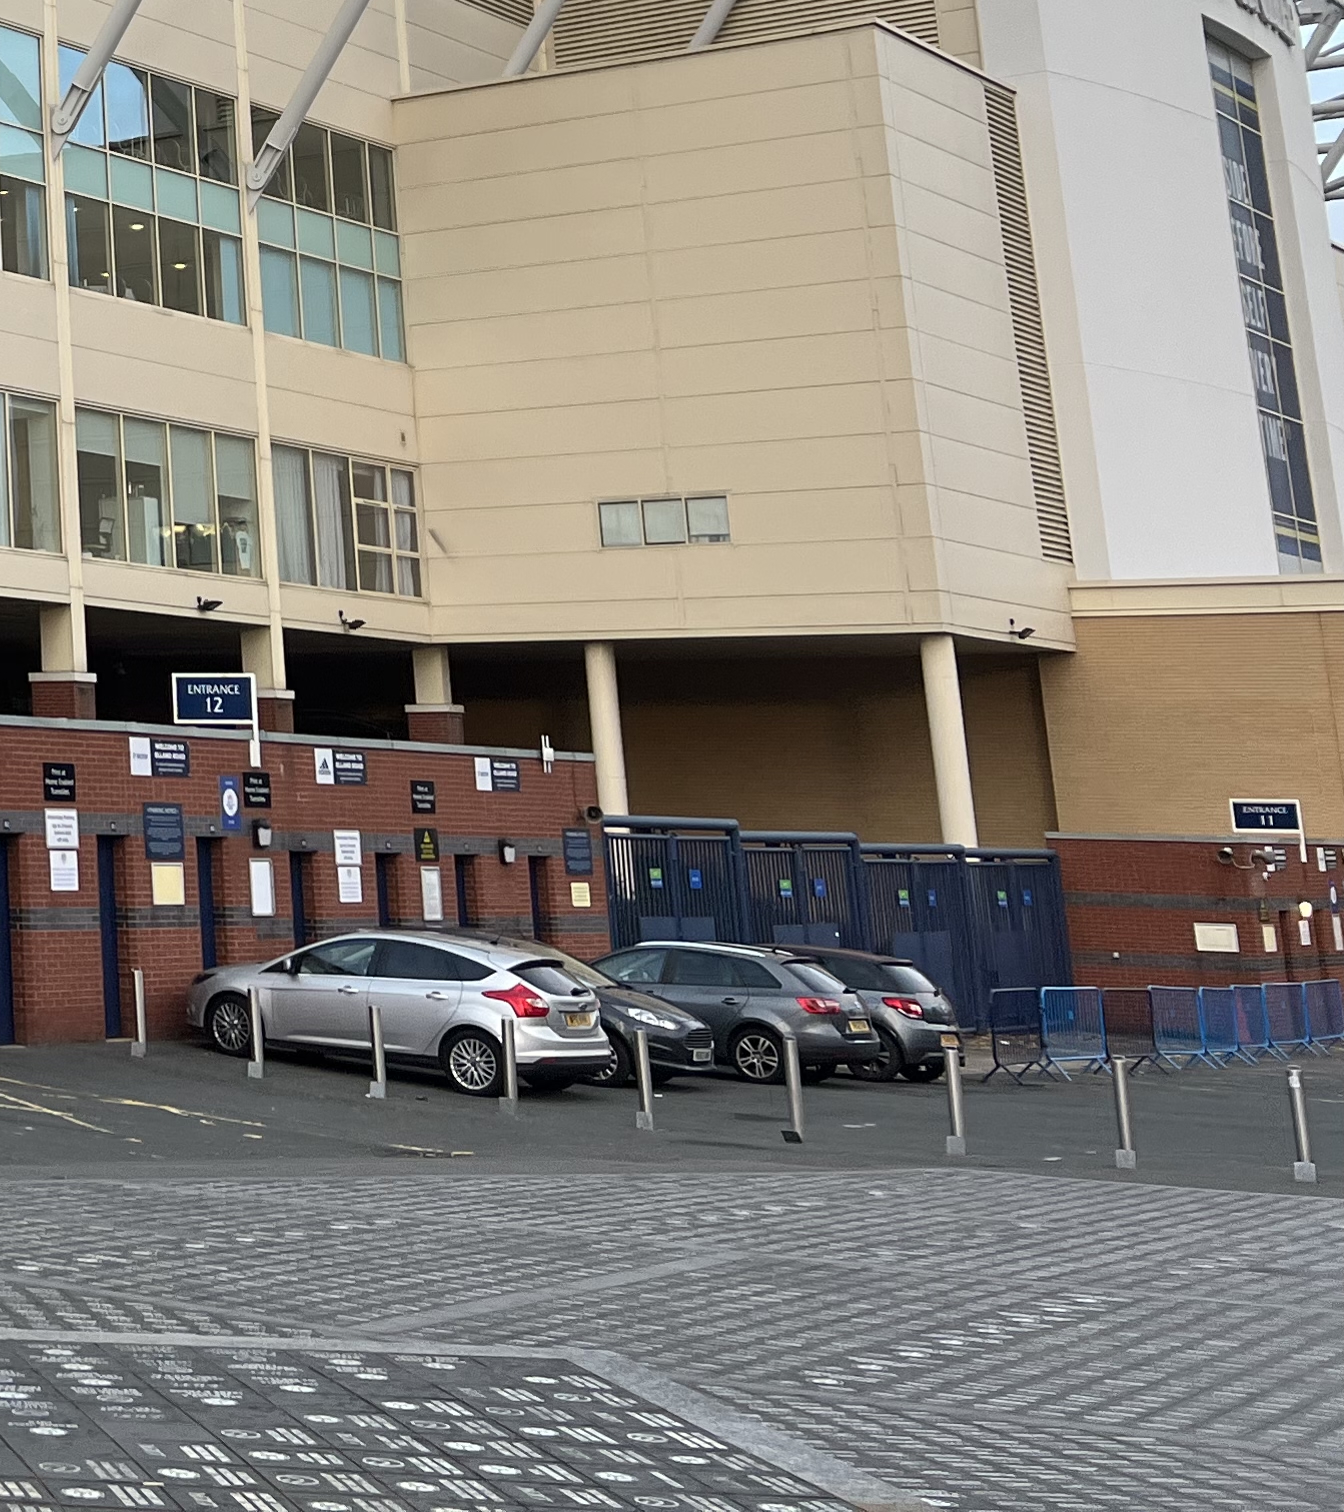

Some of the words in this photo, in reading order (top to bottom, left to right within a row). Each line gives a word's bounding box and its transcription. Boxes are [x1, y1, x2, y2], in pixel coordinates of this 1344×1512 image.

[187, 684, 240, 695] ENTRANCE
[205, 697, 224, 713] 12
[1242, 806, 1289, 814] ENTRANCE
[1260, 815, 1274, 826] 11
